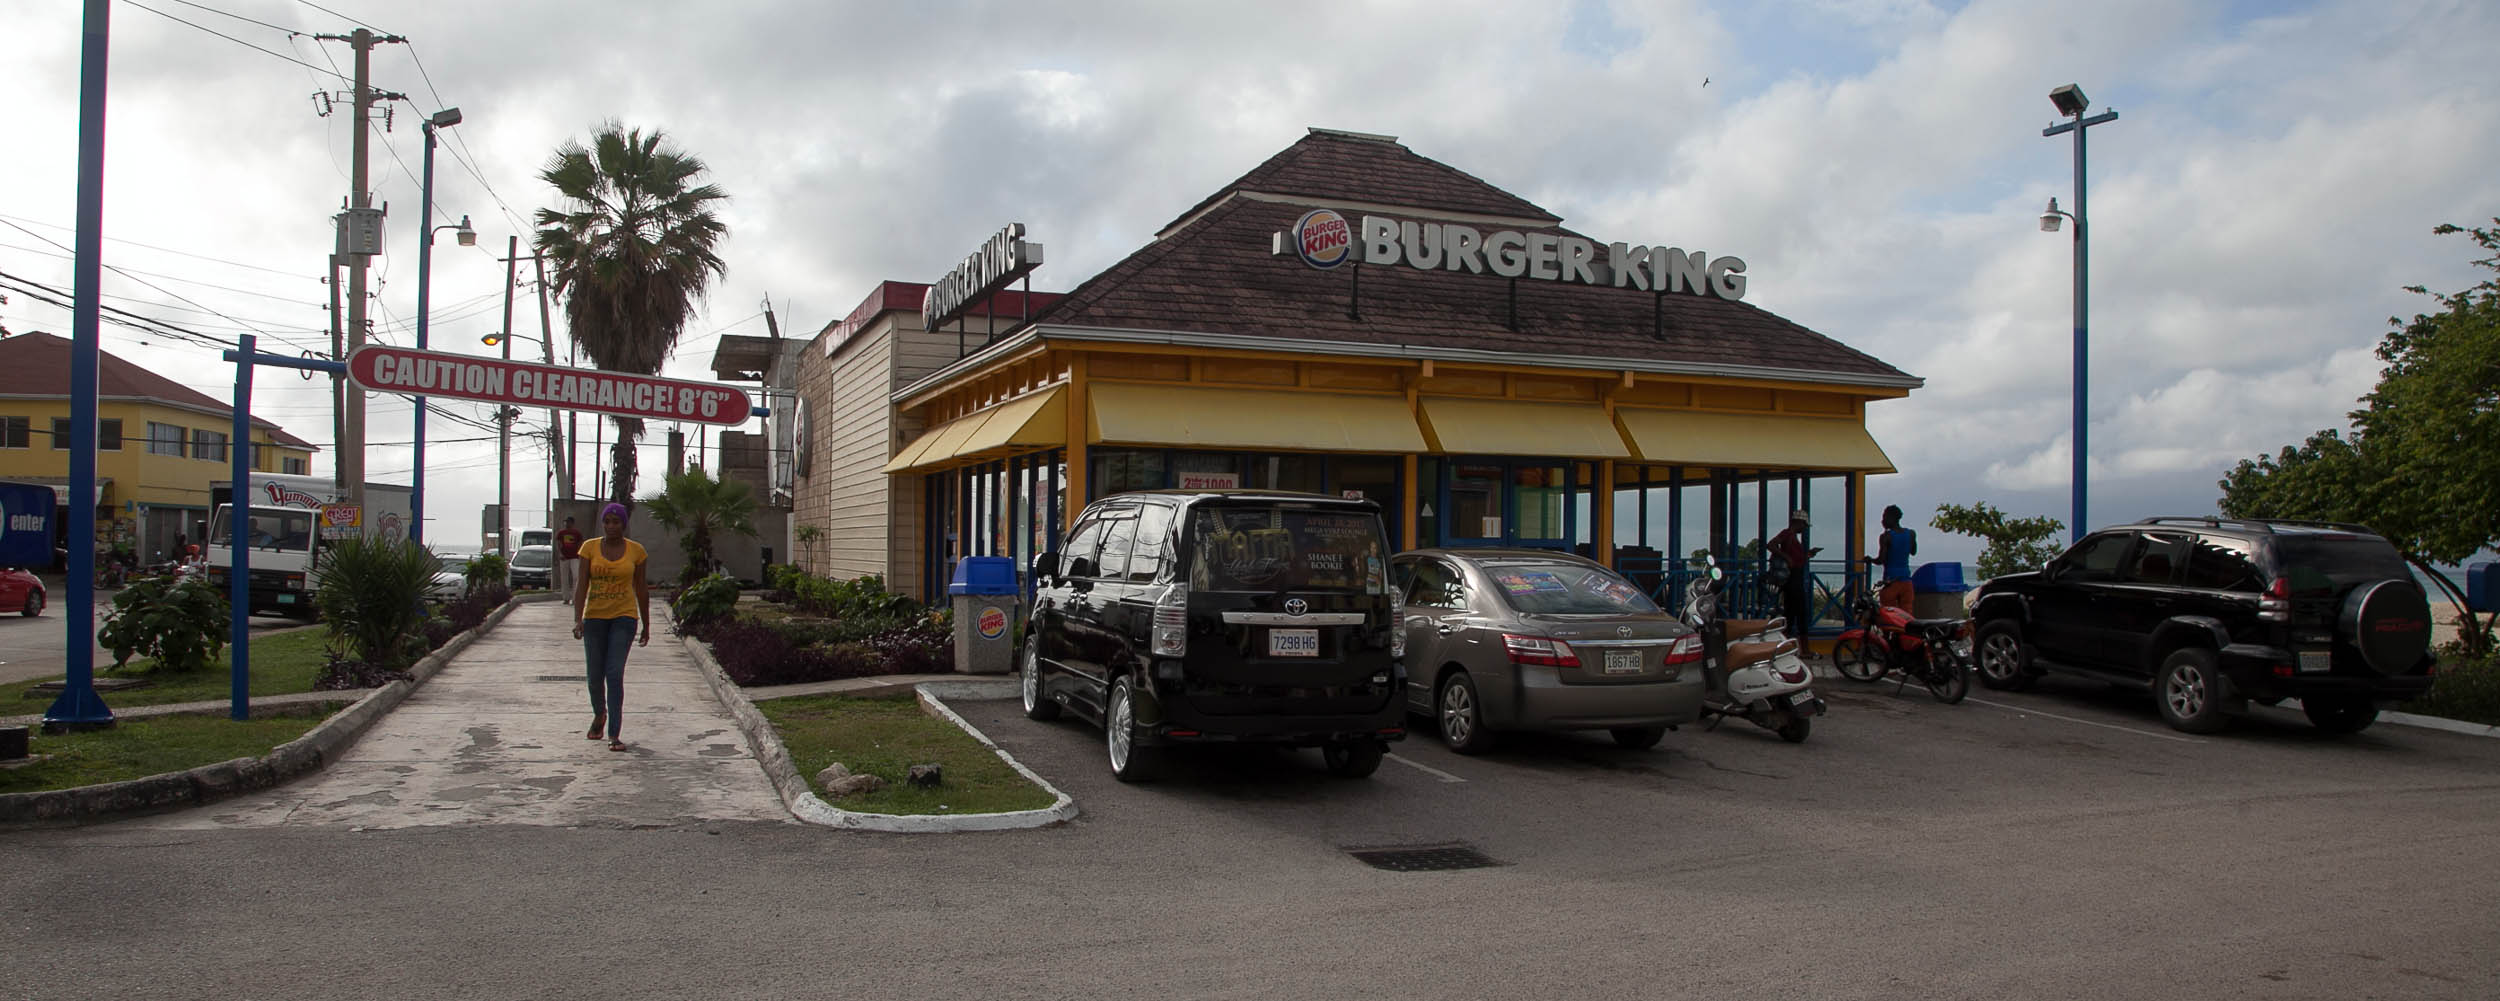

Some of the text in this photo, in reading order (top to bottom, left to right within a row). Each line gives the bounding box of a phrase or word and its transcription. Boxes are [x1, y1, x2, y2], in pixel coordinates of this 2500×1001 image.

[1304, 220, 1346, 240] BURGER
[1305, 230, 1348, 256] KING
[1363, 216, 1747, 301] BURGER KING
[935, 223, 1021, 320] BURGER KING
[373, 354, 505, 395] CAUTION
[512, 369, 674, 413] CLEARANCE!
[11, 514, 46, 531] enter
[1307, 552, 1337, 562] SHANE
[1311, 561, 1344, 570] BOOKIE
[980, 619, 1004, 632] KING
[1274, 635, 1316, 650] 7298 HG
[1607, 656, 1627, 669] 1867
